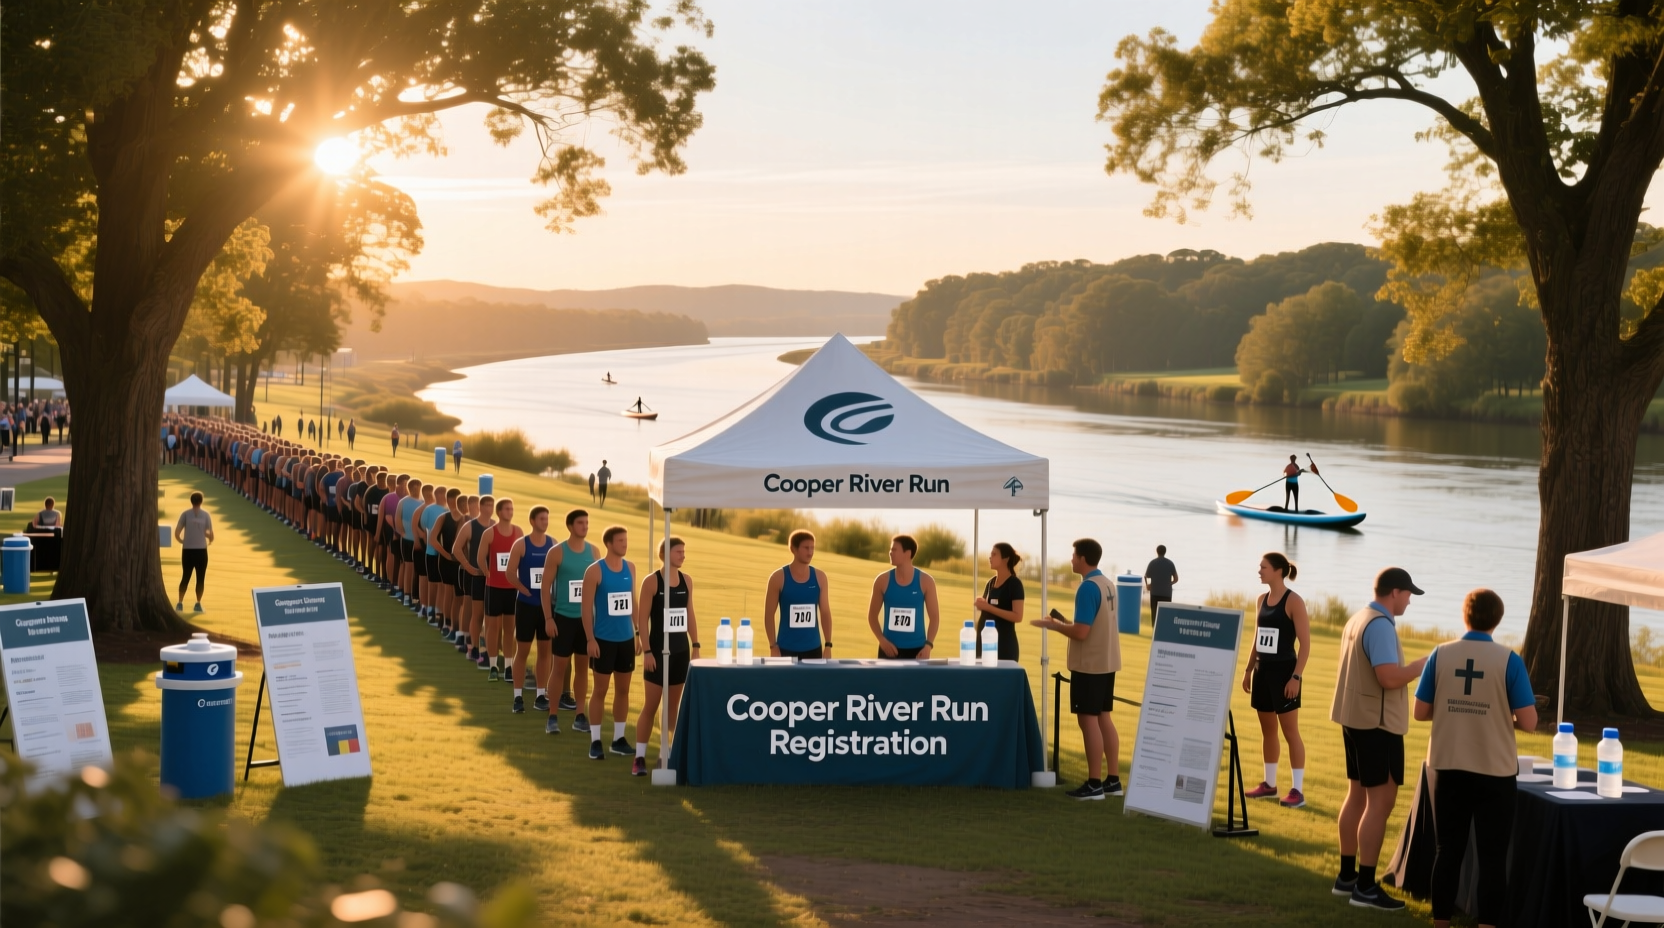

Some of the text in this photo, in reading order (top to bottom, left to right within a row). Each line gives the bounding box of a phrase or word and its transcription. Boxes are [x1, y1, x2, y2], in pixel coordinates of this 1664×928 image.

[763, 473, 950, 498] Cooper River Run
[726, 693, 989, 728] Cooper River Run
[770, 728, 947, 762] Registration
